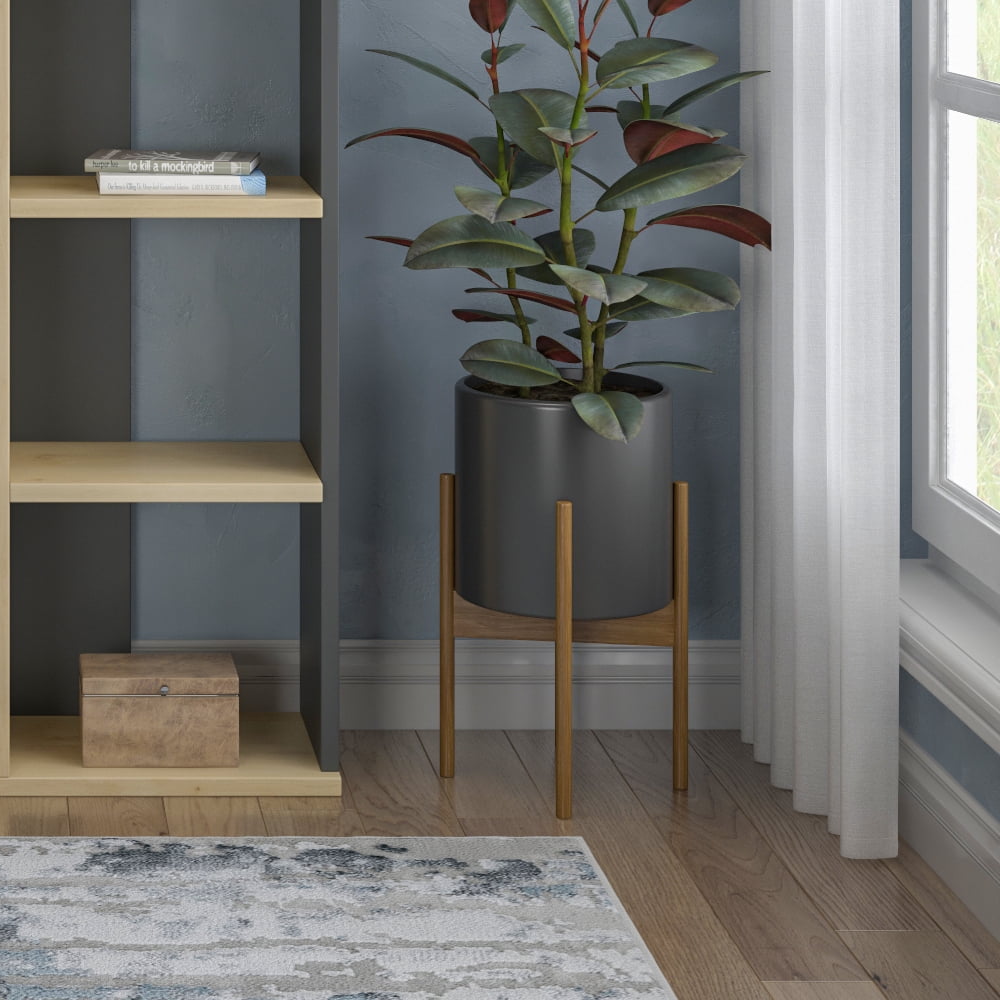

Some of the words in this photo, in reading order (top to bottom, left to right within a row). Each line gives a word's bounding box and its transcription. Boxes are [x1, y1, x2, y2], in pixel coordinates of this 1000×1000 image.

[128, 161, 138, 171] to
[140, 160, 151, 171] kill
[153, 163, 159, 172] a
[161, 161, 215, 174] mockingbird
